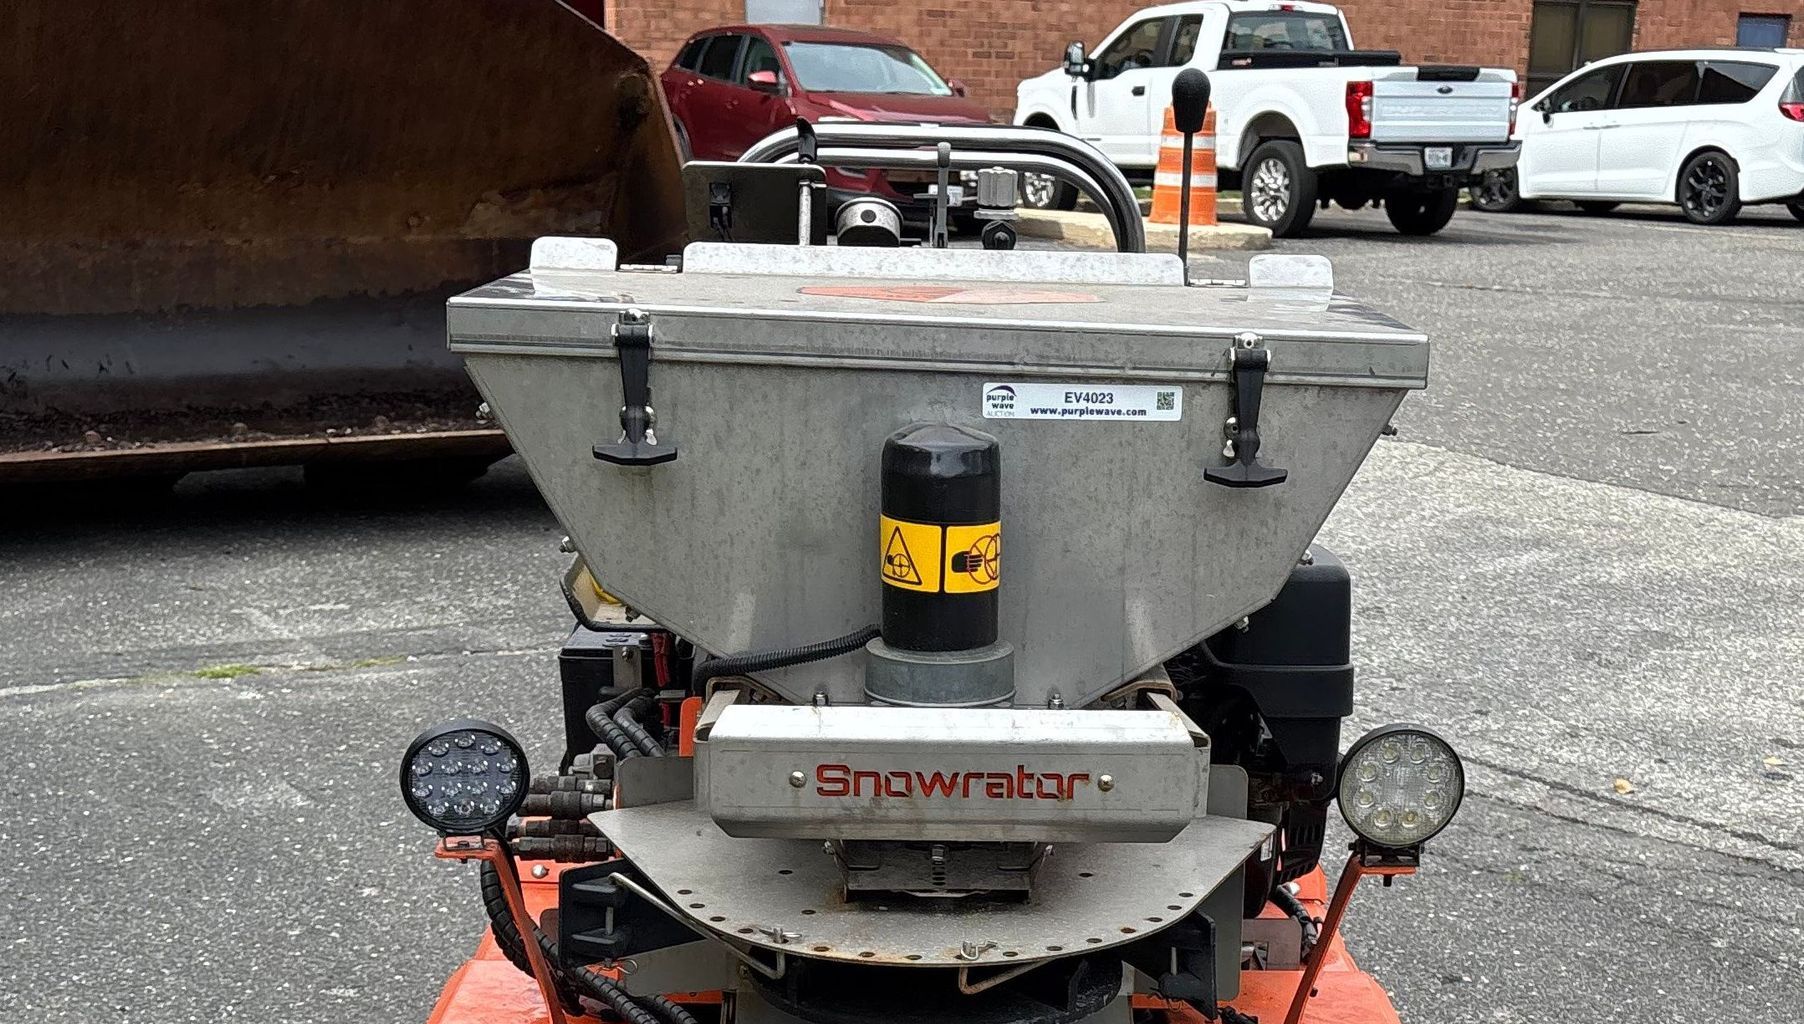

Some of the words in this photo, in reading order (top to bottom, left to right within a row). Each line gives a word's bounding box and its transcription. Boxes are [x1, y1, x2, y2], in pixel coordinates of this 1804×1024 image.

[986, 393, 1015, 403] purple
[1064, 391, 1114, 404] EV4023
[991, 402, 1015, 410] wave
[1030, 405, 1147, 417] www.purplewave.com
[815, 763, 1090, 800] Snowrator
